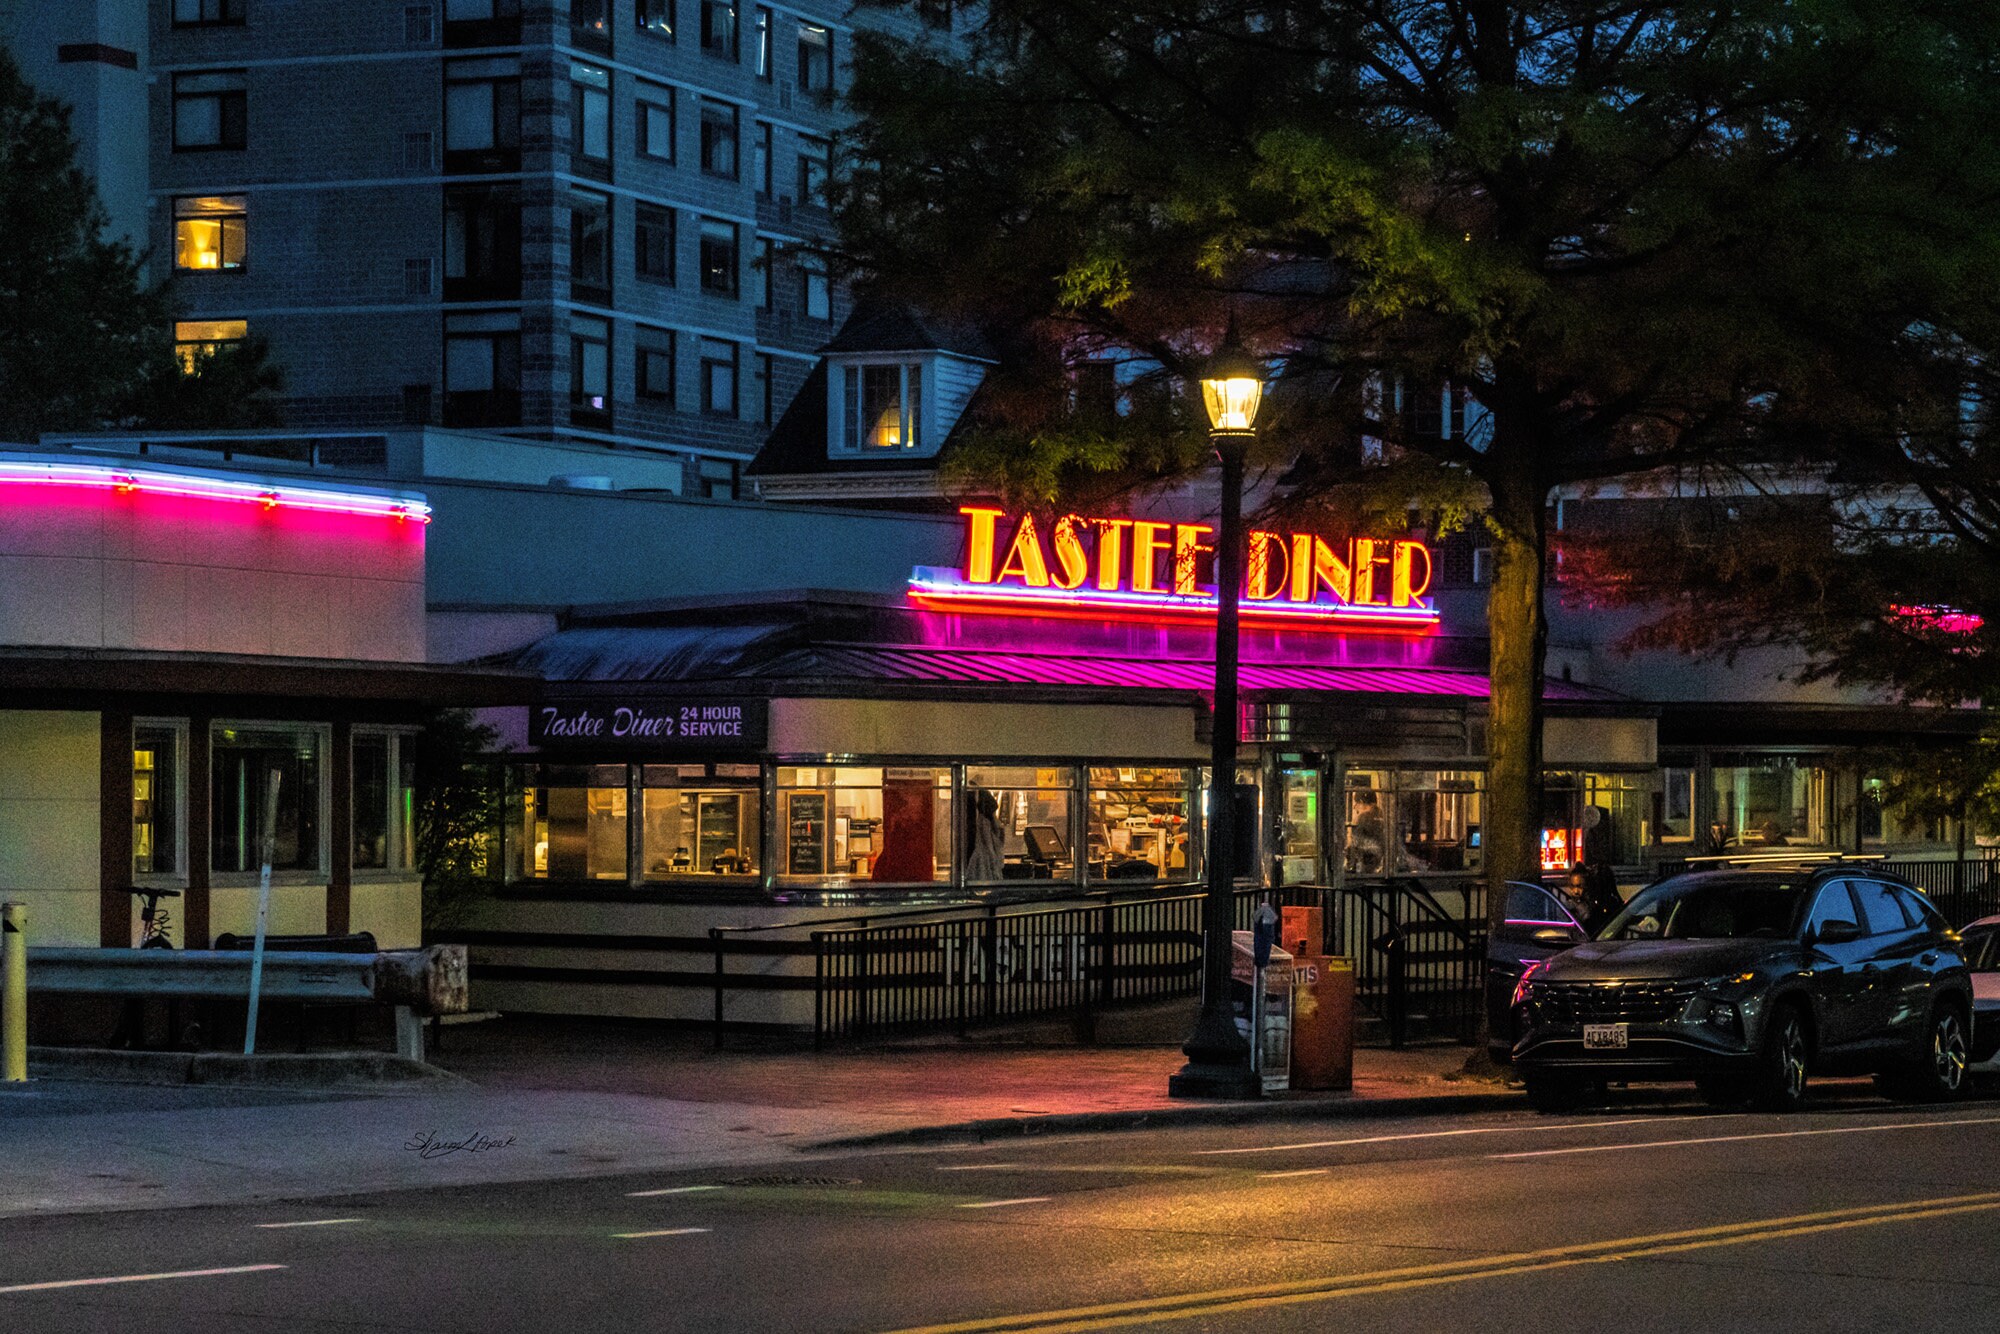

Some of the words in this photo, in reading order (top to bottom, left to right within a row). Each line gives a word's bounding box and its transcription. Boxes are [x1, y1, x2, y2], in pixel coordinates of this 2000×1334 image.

[959, 507, 1214, 597] TASTEE
[1247, 529, 1432, 609] DINER
[542, 708, 604, 736] Tastee
[611, 707, 674, 736] Diner
[680, 706, 698, 720] 24
[702, 706, 742, 720] HOUR
[679, 721, 742, 736] SERVICE
